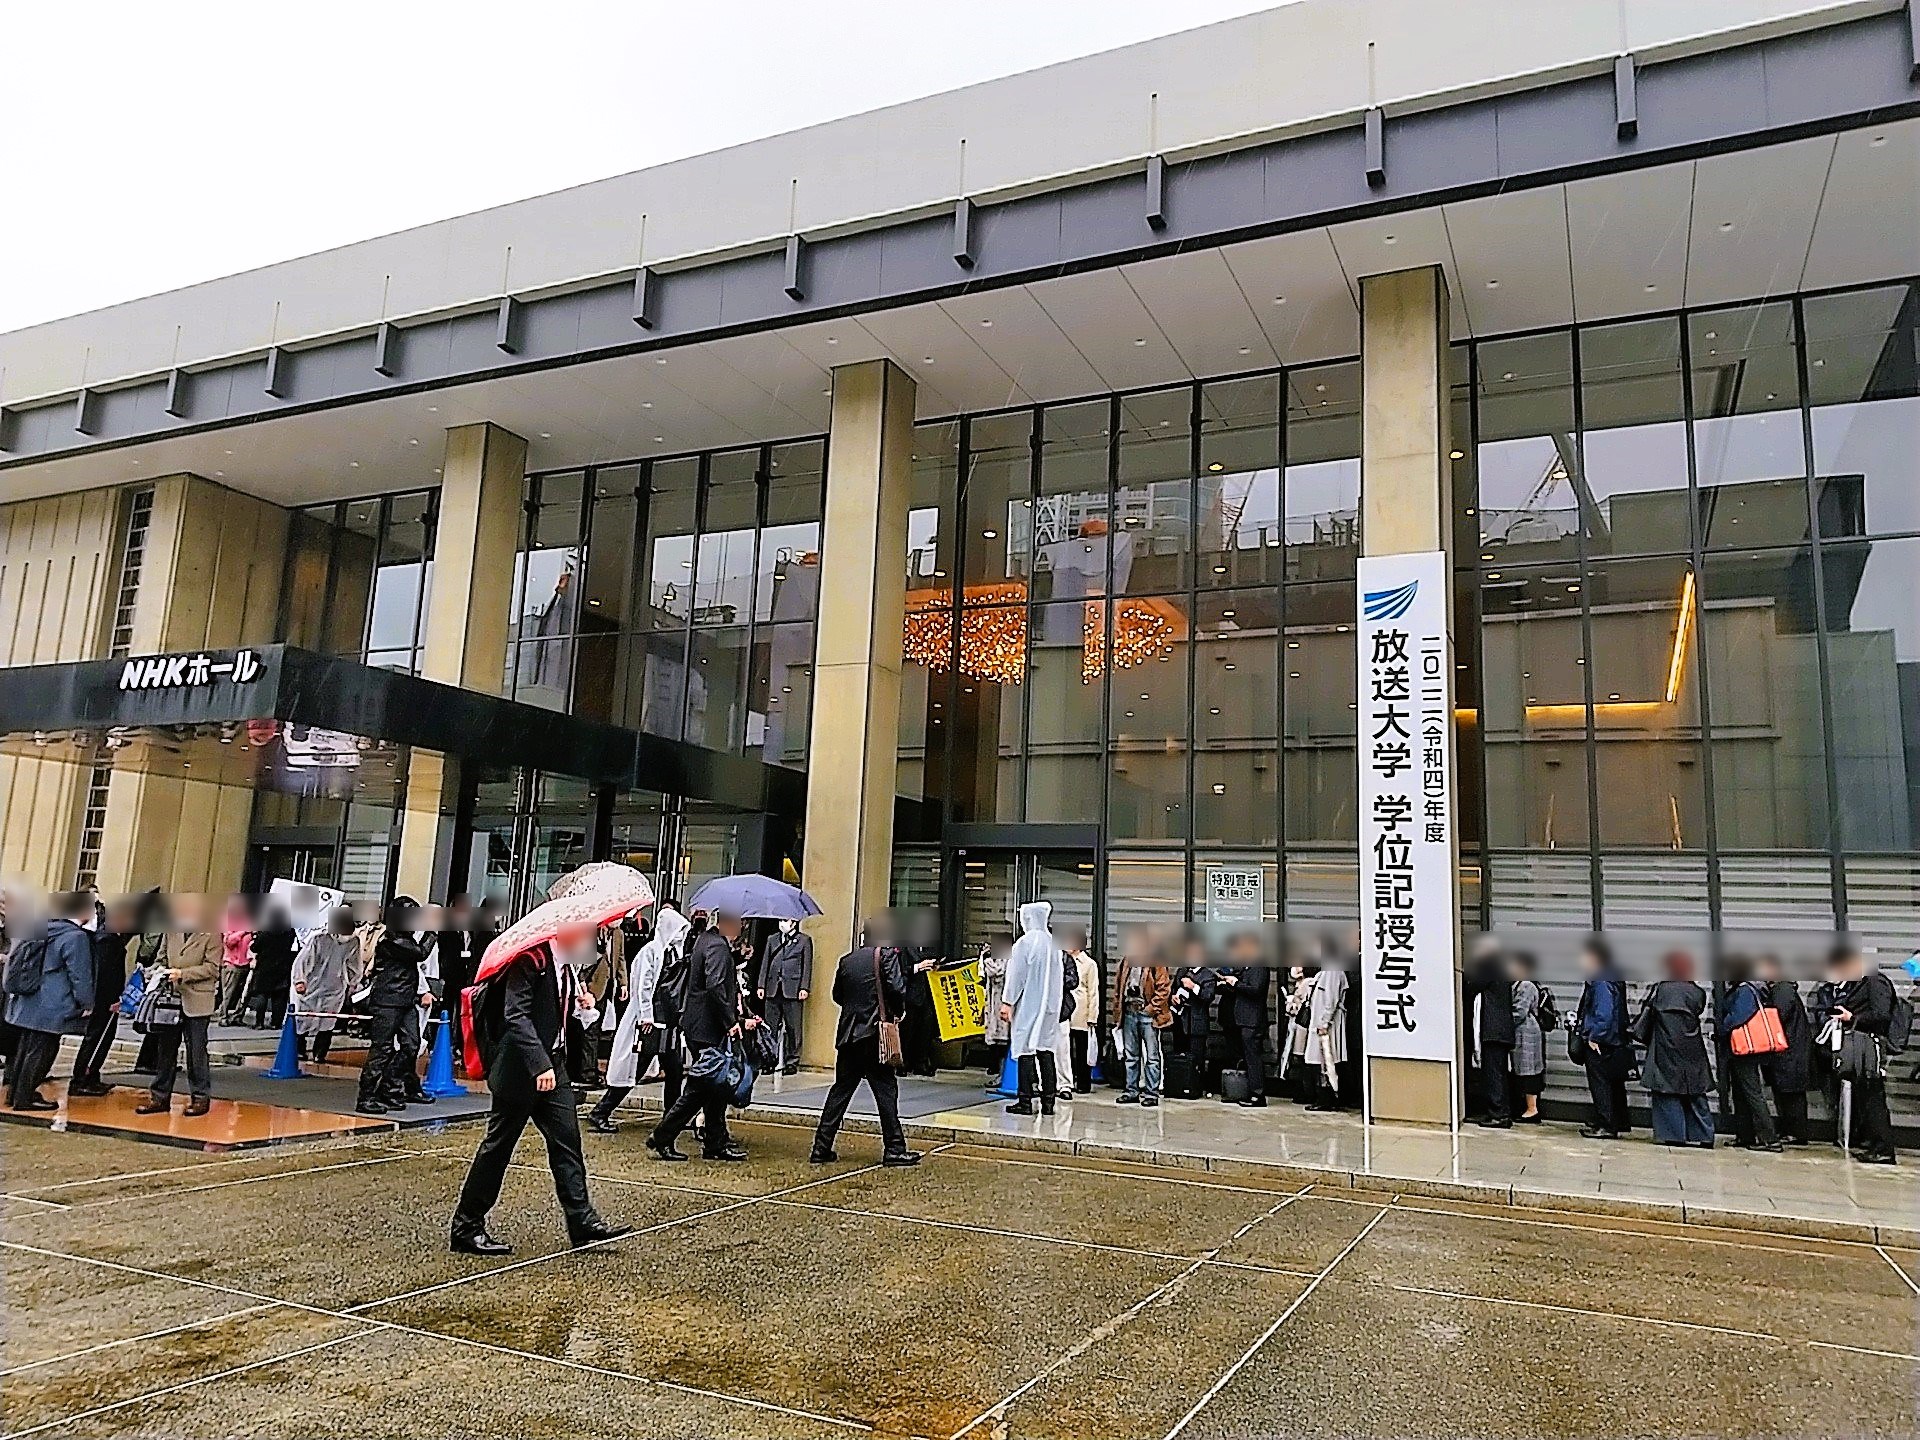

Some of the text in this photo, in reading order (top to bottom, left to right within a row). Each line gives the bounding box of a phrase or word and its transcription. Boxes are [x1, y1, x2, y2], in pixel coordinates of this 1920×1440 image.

[119, 650, 258, 690] NHKホール
[1371, 628, 1417, 1033] 放送大学 学位記授与式
